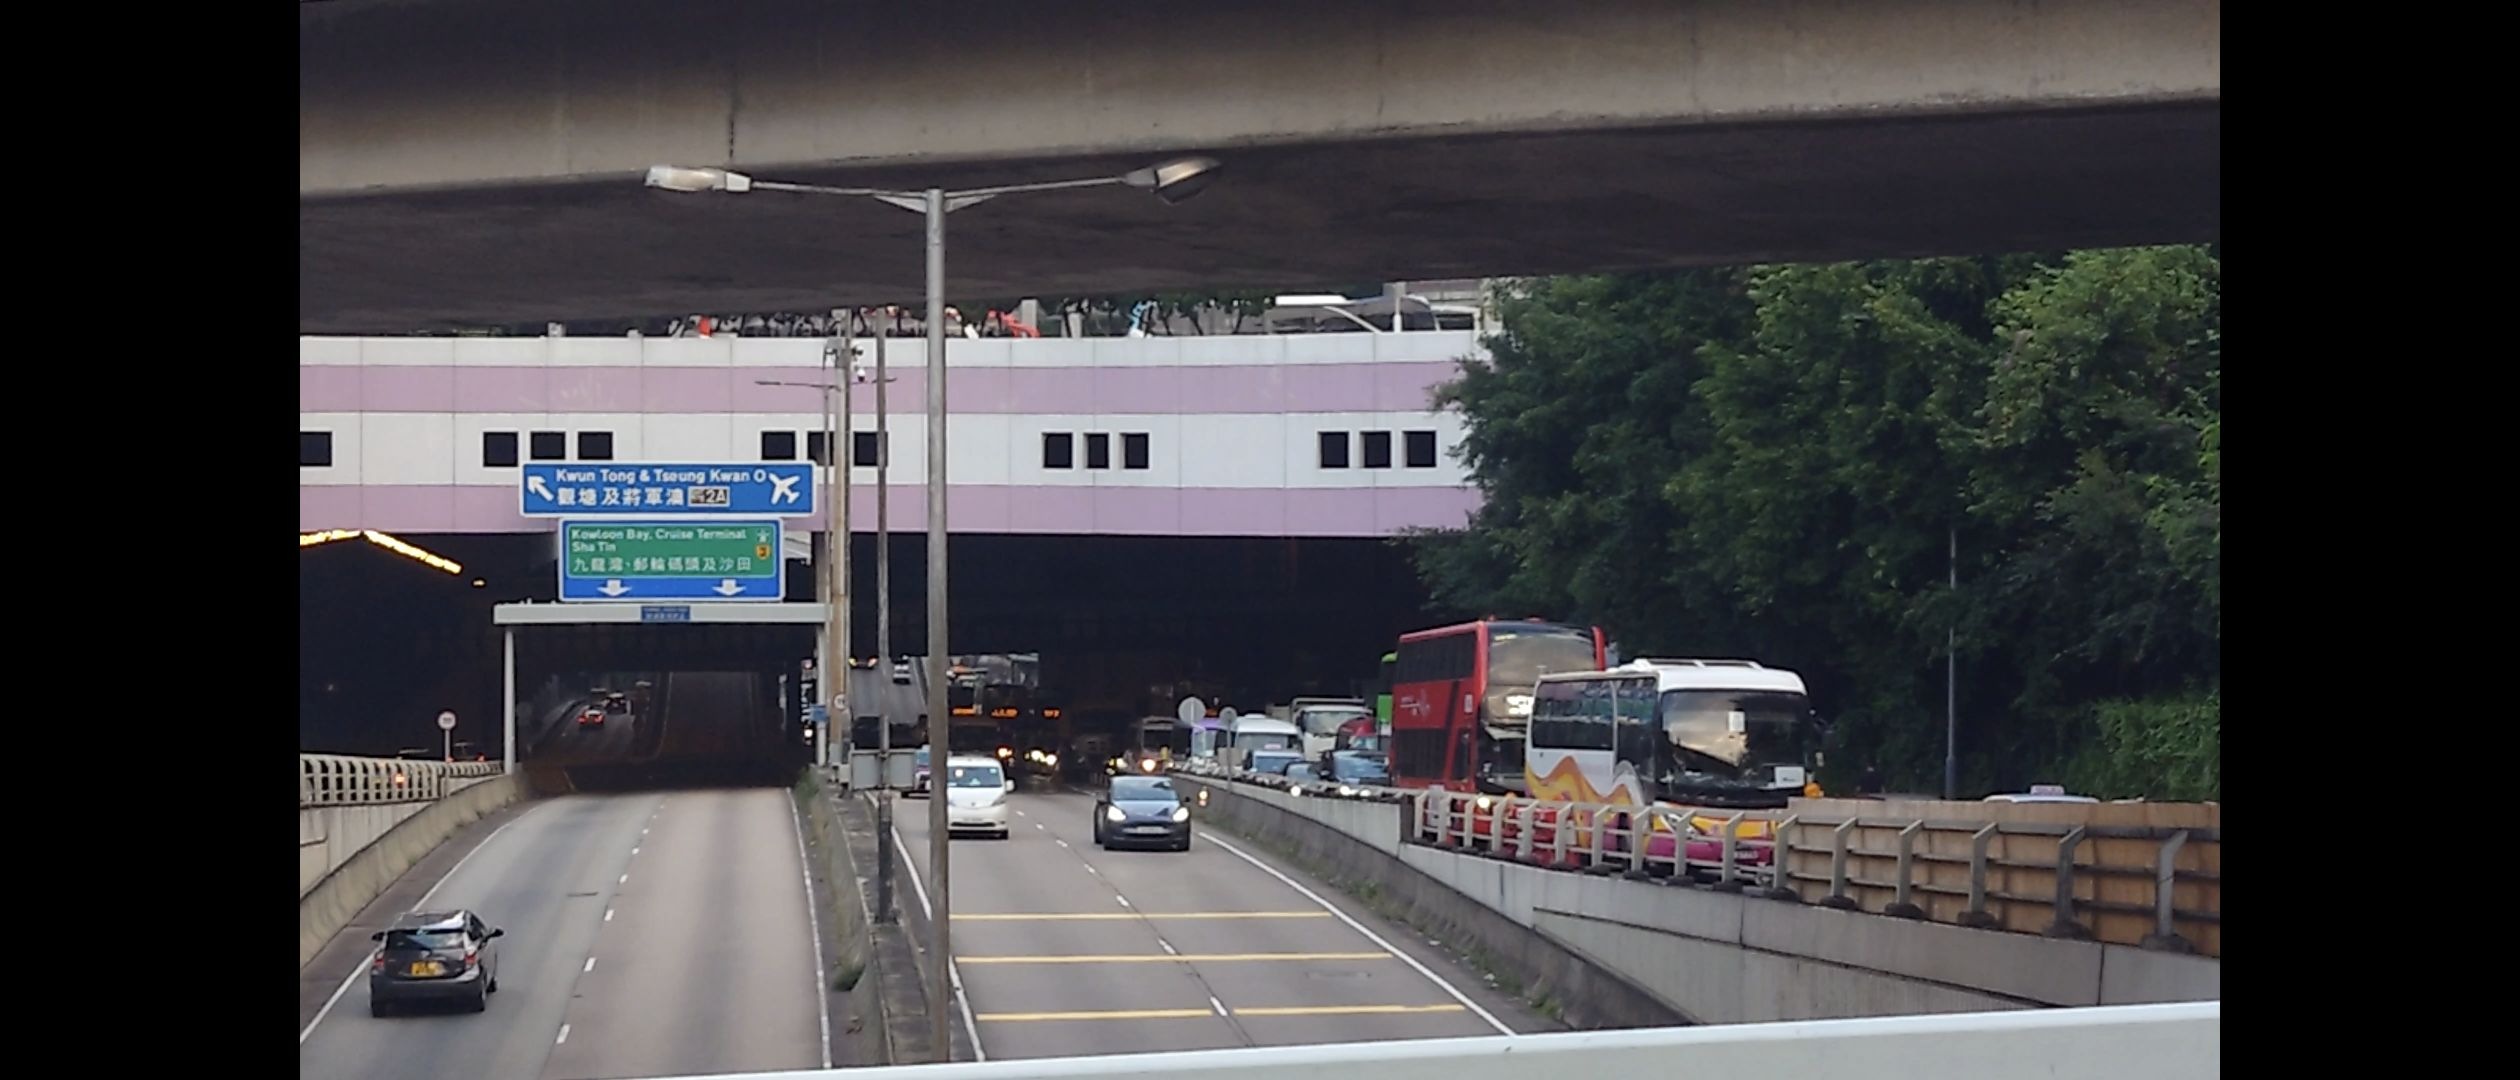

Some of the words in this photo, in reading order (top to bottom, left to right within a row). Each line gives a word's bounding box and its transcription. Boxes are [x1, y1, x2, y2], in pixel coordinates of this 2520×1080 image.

[556, 469, 596, 482] Kwun
[600, 469, 636, 485] Tong
[640, 469, 651, 482] &
[653, 469, 706, 485] Tseung
[709, 469, 751, 482] Kwan
[753, 469, 767, 482] O
[705, 488, 727, 503] 2A
[571, 529, 624, 539] Kowloon
[655, 529, 694, 540] Cruise
[696, 528, 747, 539] Terminal
[571, 541, 595, 552] Sha
[597, 541, 617, 552] Tin
